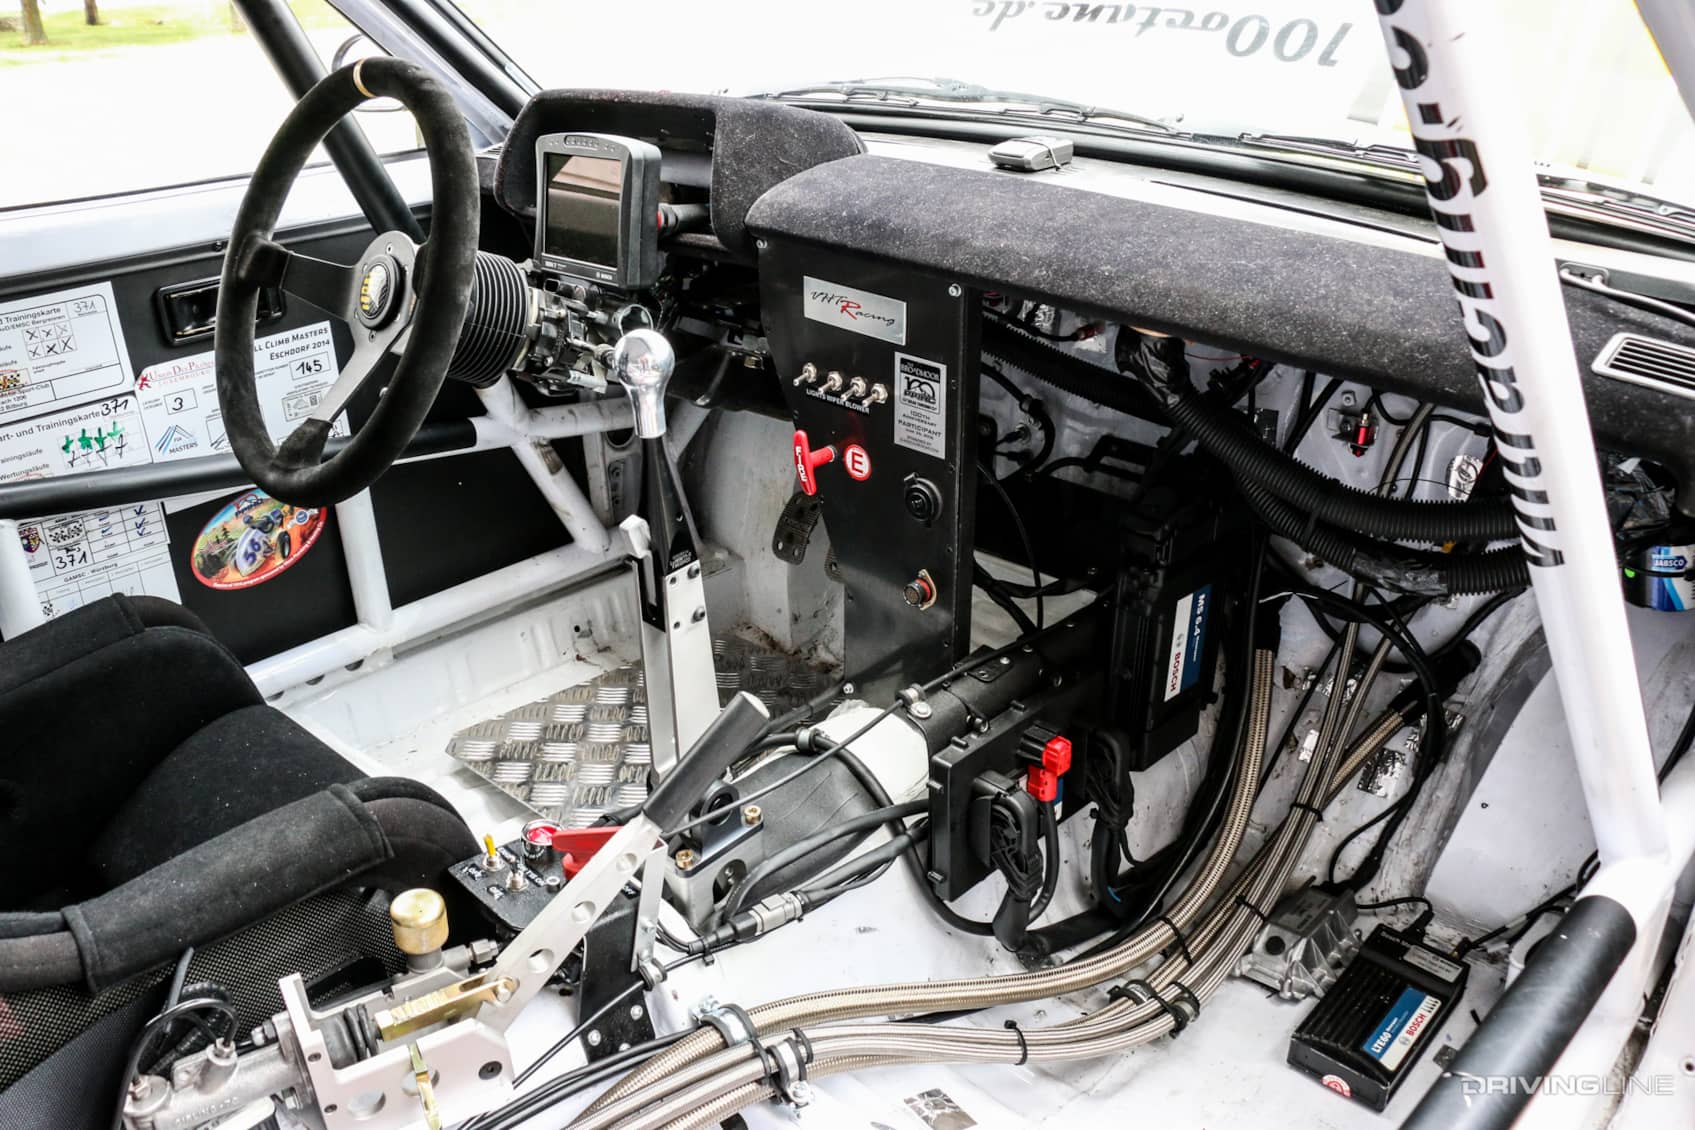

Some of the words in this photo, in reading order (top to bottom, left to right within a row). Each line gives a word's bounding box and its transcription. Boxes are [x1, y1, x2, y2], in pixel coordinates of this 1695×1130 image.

[6, 307, 61, 323] Trainingskarte
[292, 327, 329, 341] MASTERS
[312, 339, 331, 349] 2014
[295, 360, 323, 375] 145
[101, 398, 128, 416] 371
[172, 397, 183, 411] 3
[16, 427, 34, 438] und
[36, 411, 100, 432] Trainingskarte
[898, 419, 942, 437] PARTICIPANT
[795, 446, 808, 482] FIRE
[851, 451, 864, 474] E
[56, 551, 88, 570] 371
[1170, 652, 1181, 692] BOSCH
[1406, 1012, 1427, 1037] BOSCH
[1370, 1031, 1392, 1053] LTE60
